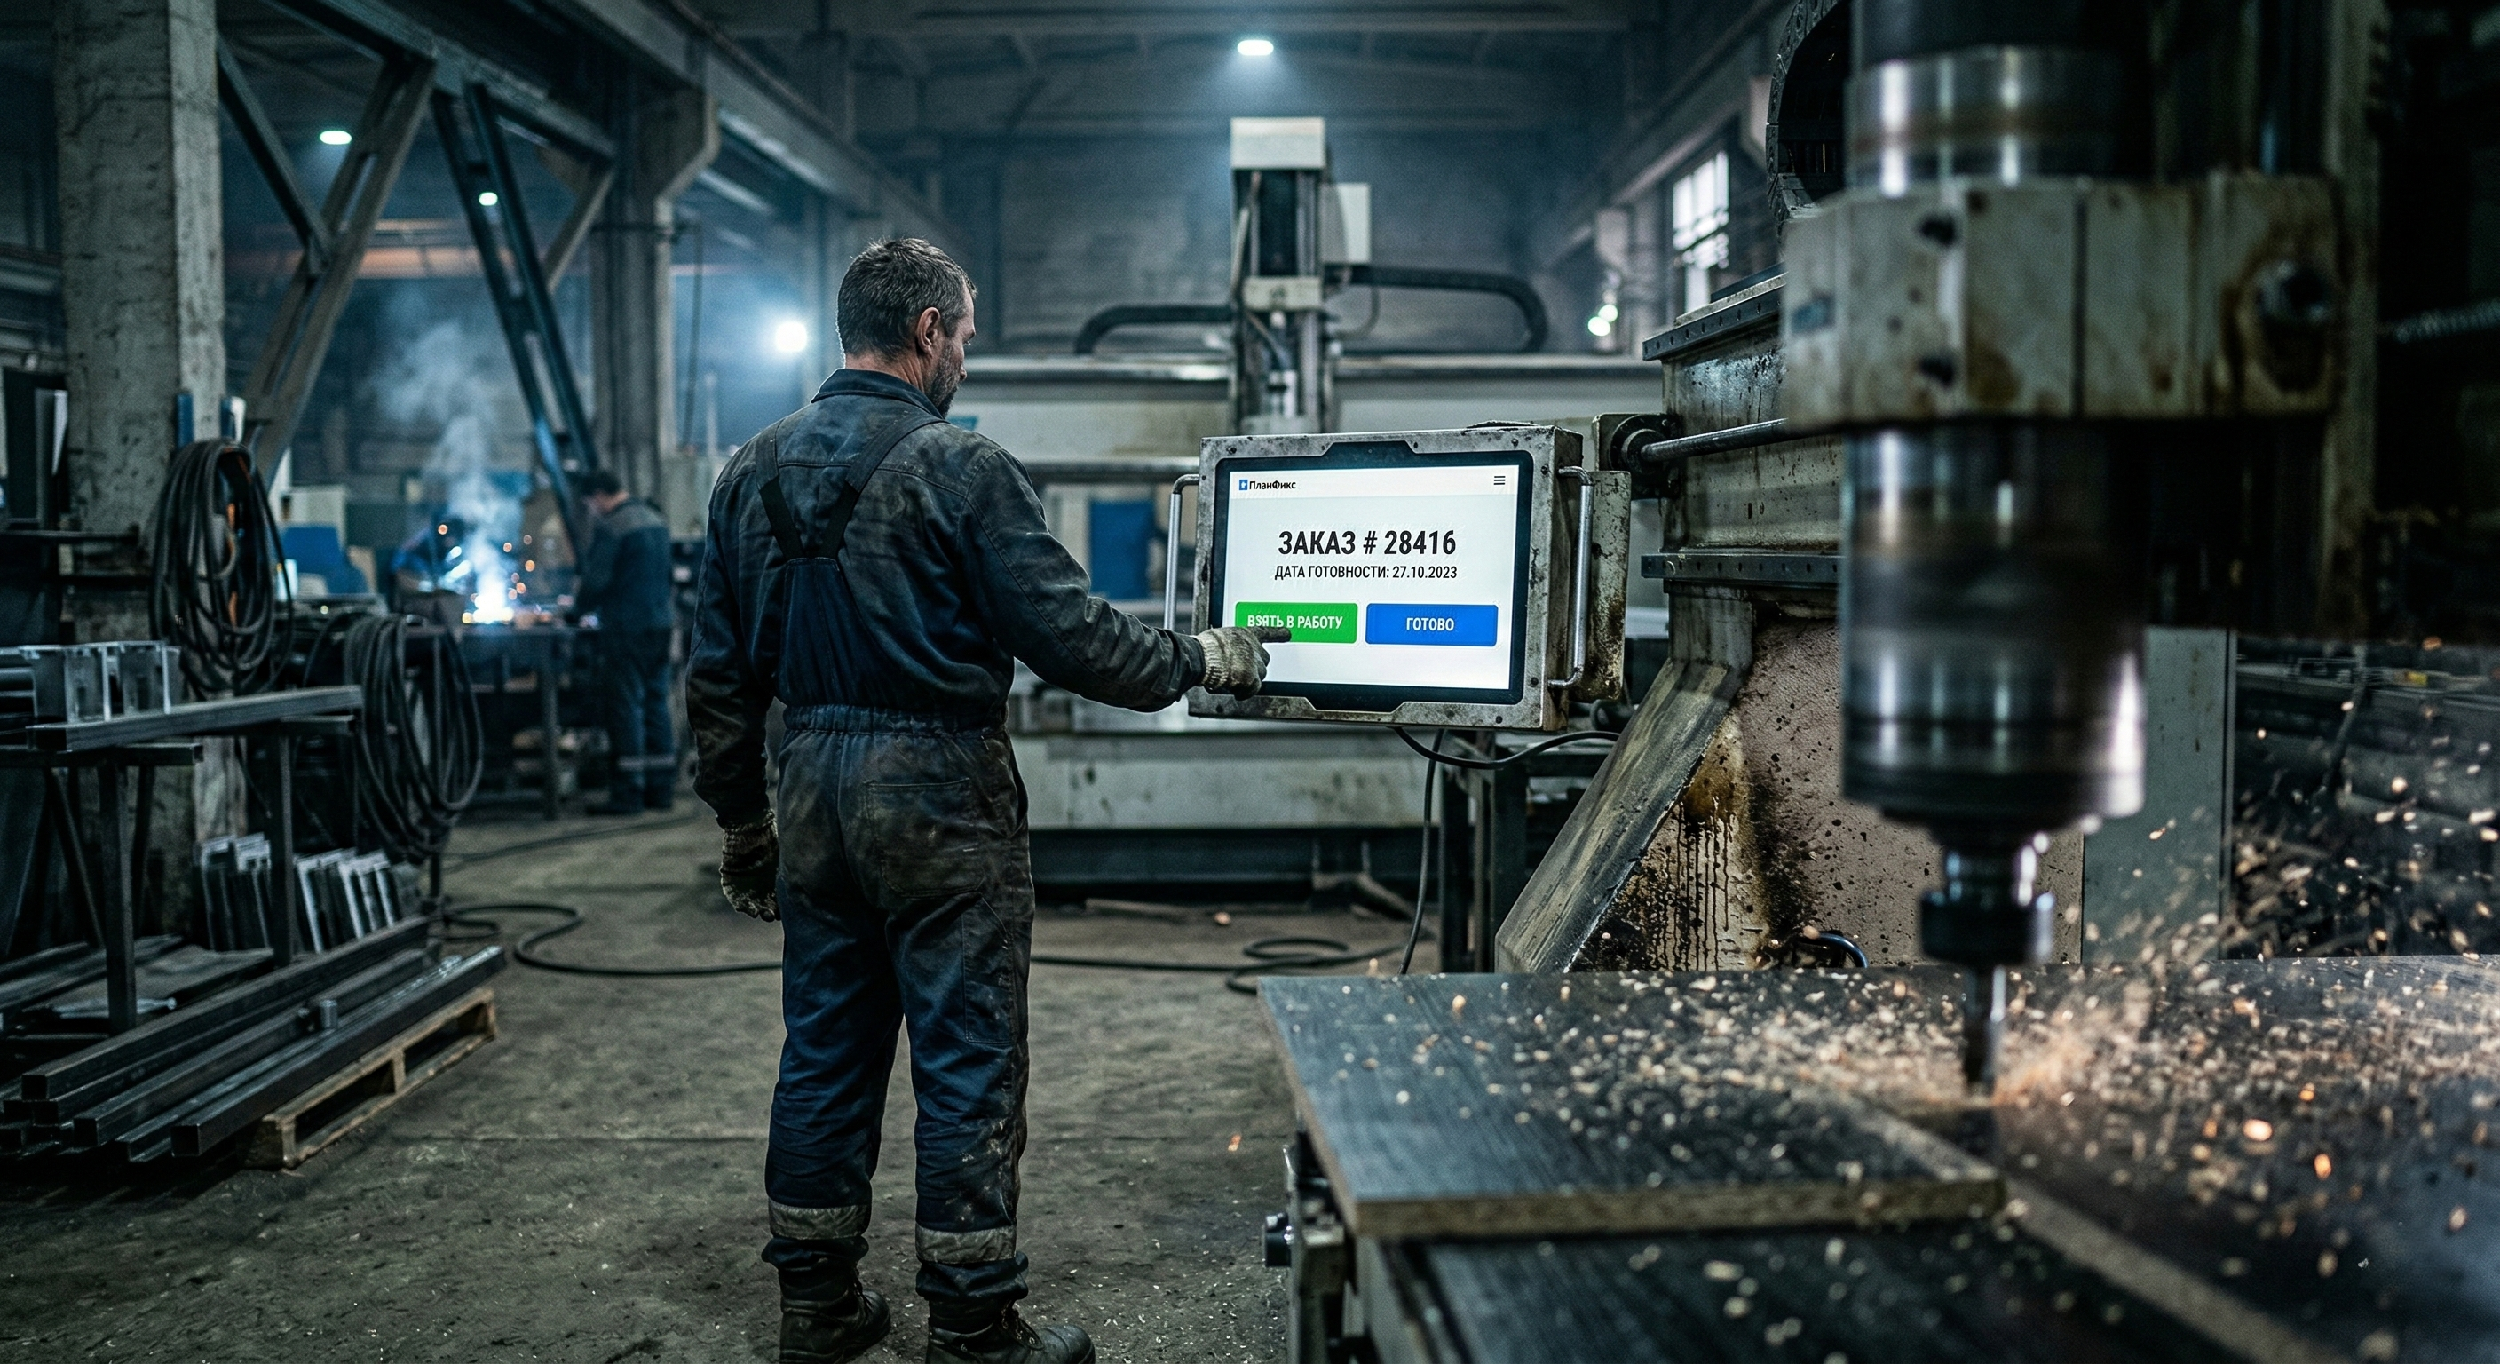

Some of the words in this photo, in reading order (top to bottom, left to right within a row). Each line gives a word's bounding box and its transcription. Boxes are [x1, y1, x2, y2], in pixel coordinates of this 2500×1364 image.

[1249, 480, 1296, 490] ПланФикс
[1278, 531, 1356, 555] ЗАКАЗ
[1363, 531, 1378, 554] #
[1384, 530, 1457, 555] 28416
[1274, 566, 1304, 580] ДАТА
[1308, 566, 1390, 578] ГОТОВНОСТИ:
[1392, 566, 1457, 579] 27.10.2023
[1286, 616, 1295, 629] В
[1297, 616, 1342, 630] РАБОТУ
[1406, 617, 1454, 631] ГОТОВО
